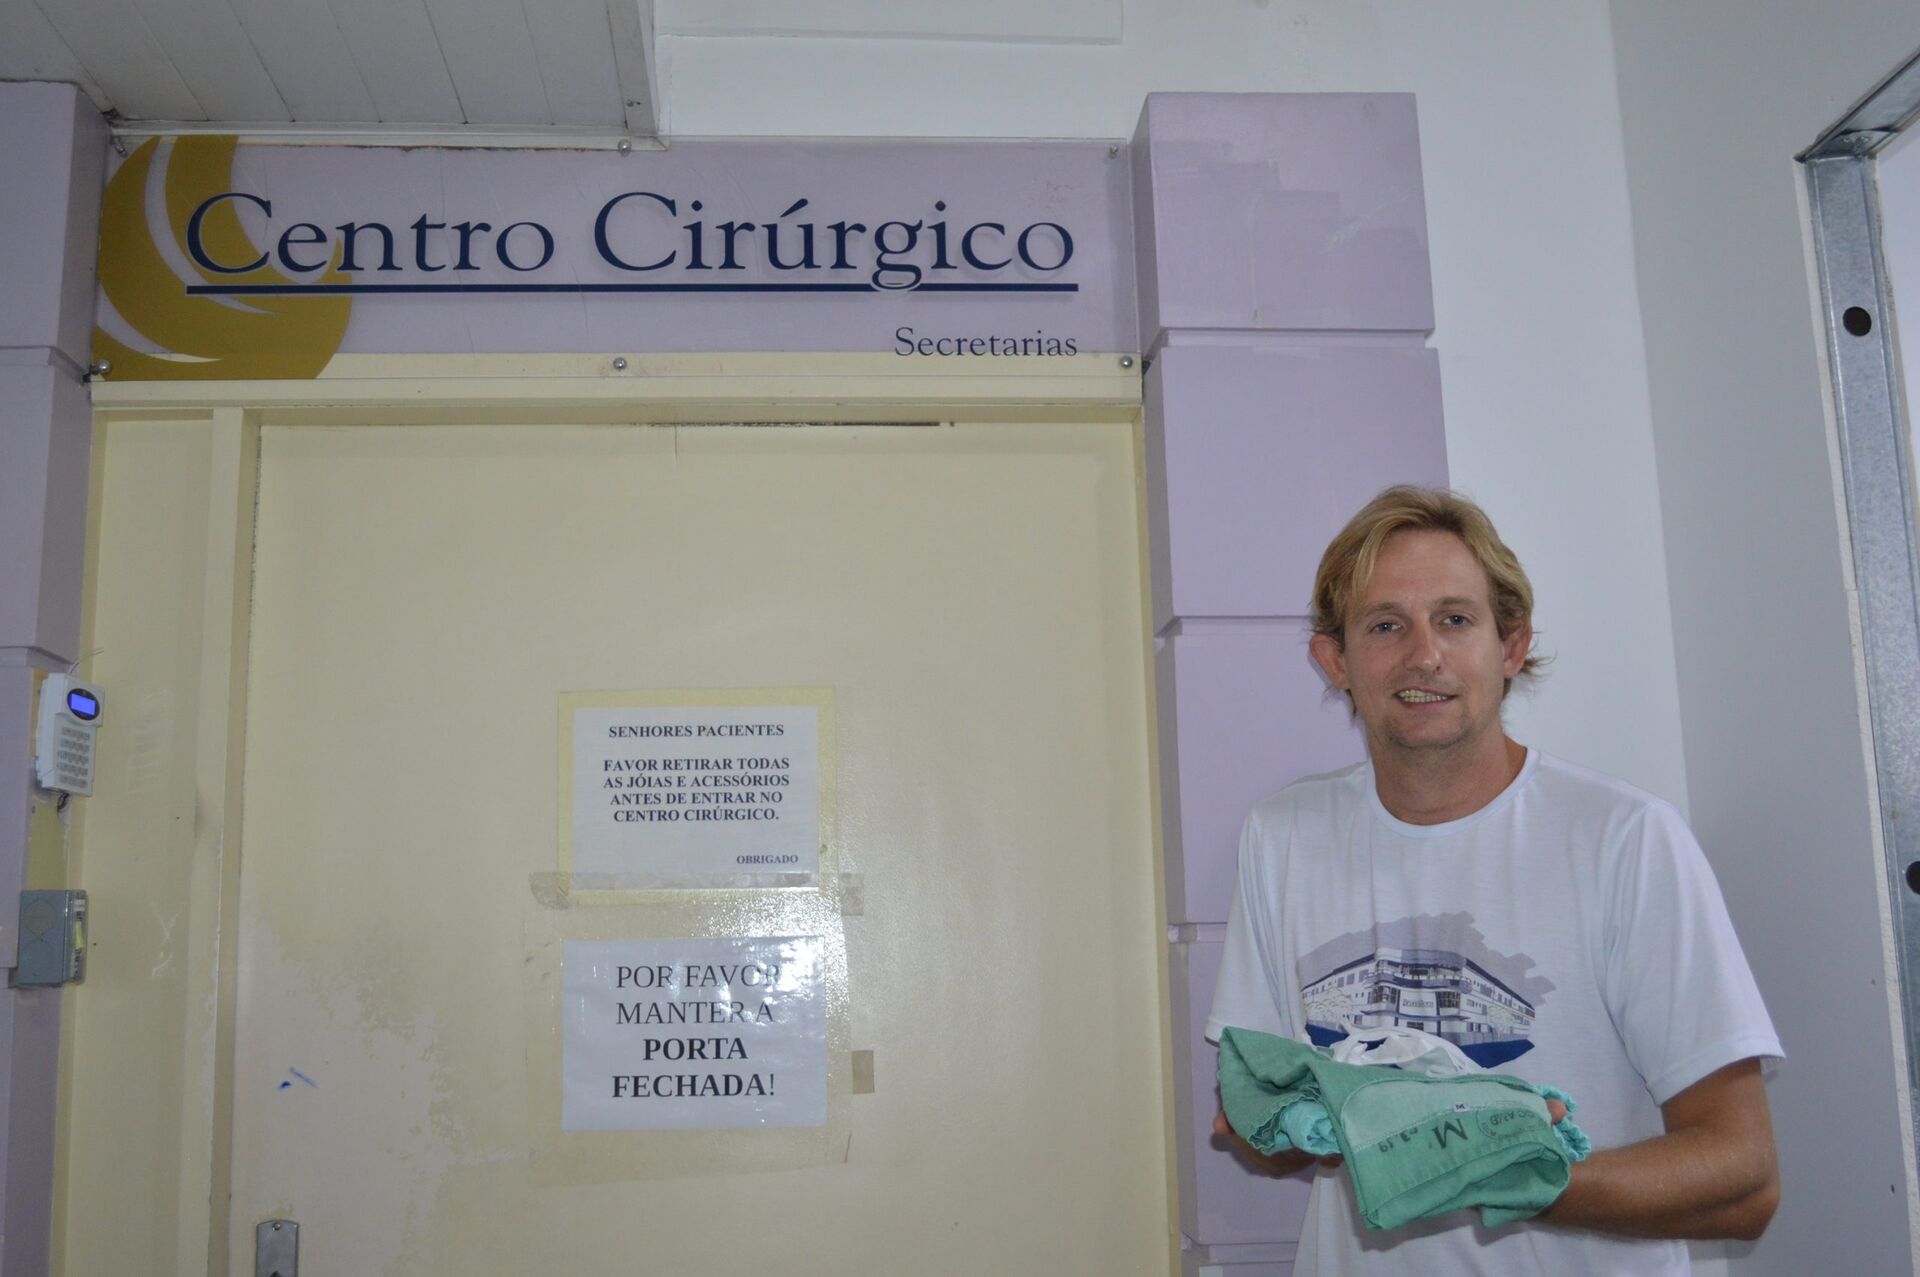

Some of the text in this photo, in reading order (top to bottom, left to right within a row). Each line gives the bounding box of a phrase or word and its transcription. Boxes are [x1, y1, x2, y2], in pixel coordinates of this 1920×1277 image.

[186, 191, 1074, 290] Centro Cirúrgico
[894, 326, 1078, 357] Secretarias
[608, 724, 785, 738] SENHORES PACIENTES
[603, 757, 790, 772] FAVOR RETIRAR TODAS
[603, 772, 790, 789] AS JÓIAS E ACESSÓRIOS
[610, 791, 783, 806] ANTES DE ENTRAR NO
[613, 806, 780, 823] CENTRO CIRÚRGICO.
[736, 854, 799, 865] OBRIGADO
[616, 964, 780, 988] POR FAVOR
[616, 1001, 774, 1025] MANTER A
[642, 1037, 749, 1061] PORTA
[611, 1073, 776, 1098] FECHADA!
[1431, 1117, 1469, 1150] M
